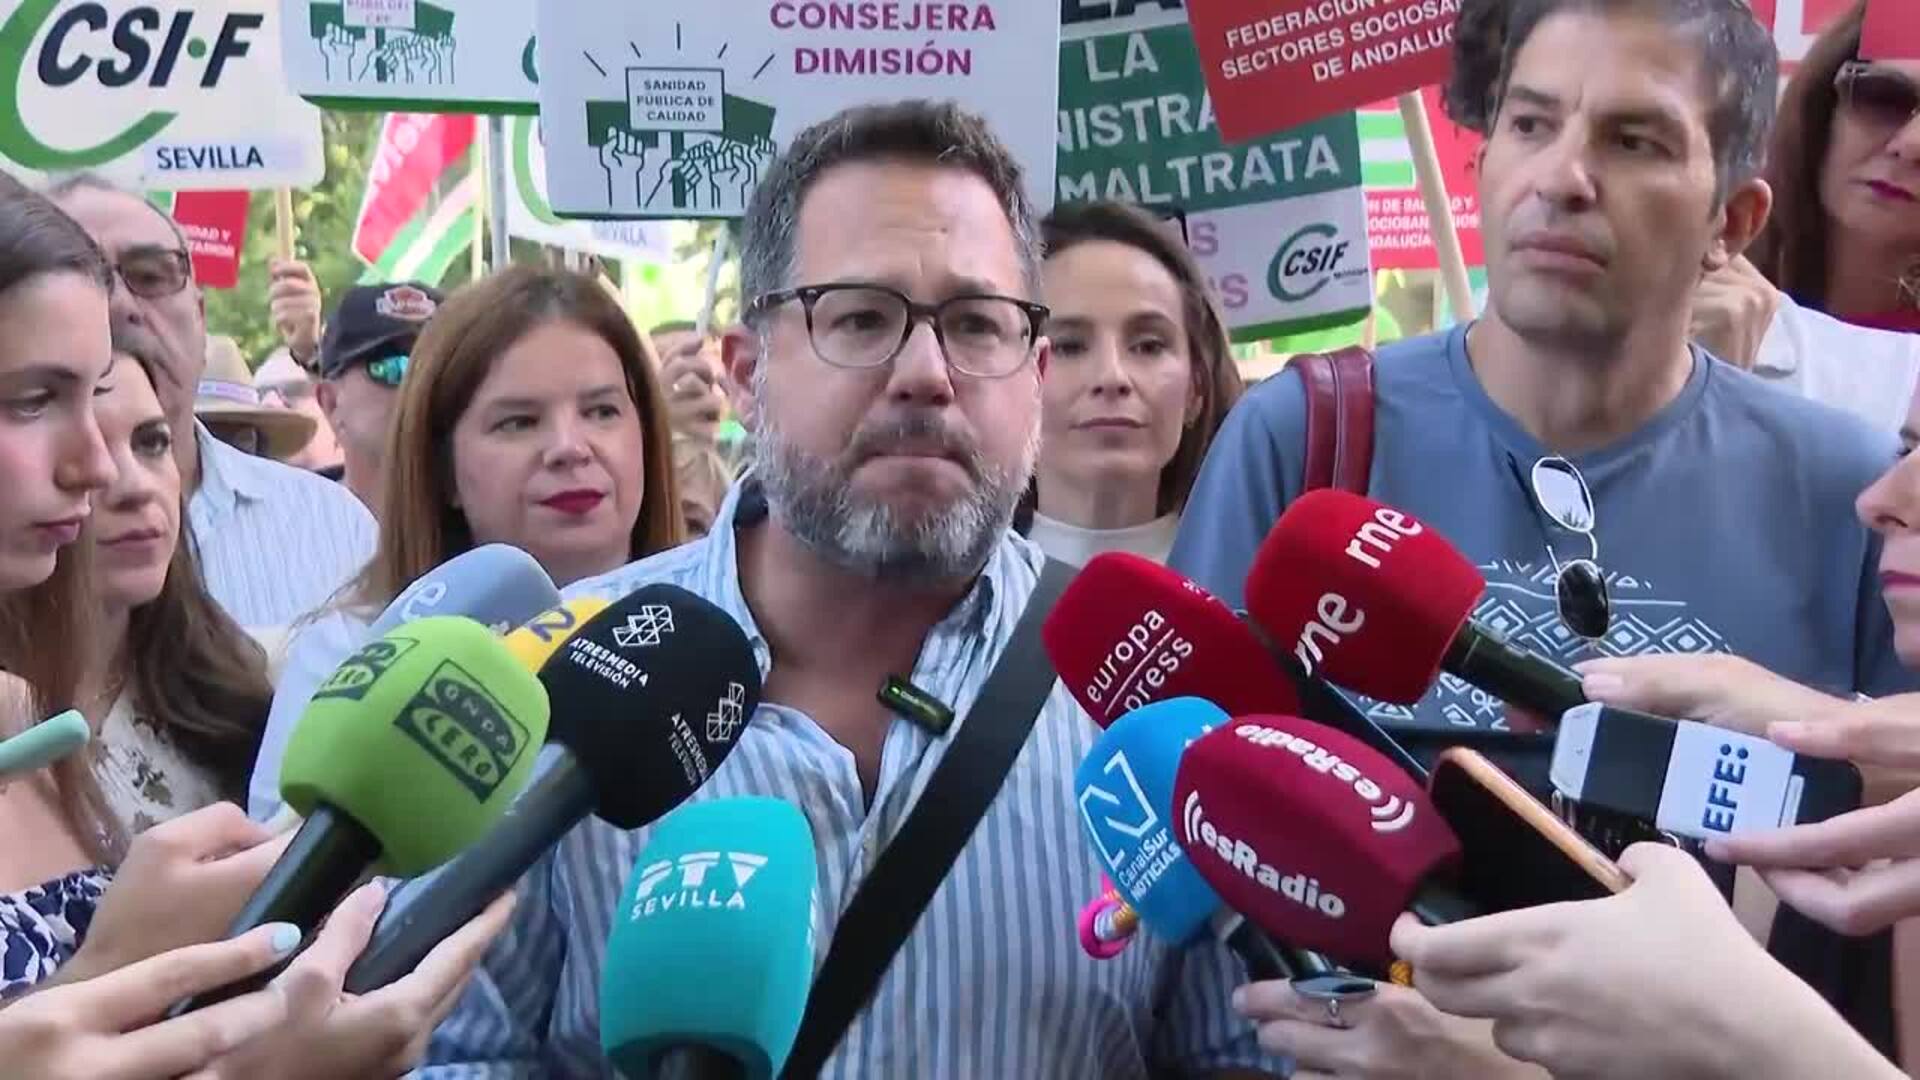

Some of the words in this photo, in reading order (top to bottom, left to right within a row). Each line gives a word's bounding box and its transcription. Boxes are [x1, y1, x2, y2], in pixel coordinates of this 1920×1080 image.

[770, 2, 996, 31] CONSEJERA
[794, 40, 971, 75] DIMISIÓN
[1084, 32, 1159, 82] LA
[1221, 30, 1345, 79] SECTORES
[1312, 57, 1345, 82] DE
[1350, 24, 1455, 72] ANDALUC
[643, 79, 706, 91] SANIDAD
[697, 96, 714, 107] DE
[647, 111, 706, 121] CALIDAD
[156, 146, 264, 169] SEVILLA
[1058, 135, 1341, 204] MALTRATA
[1284, 240, 1350, 276] CSIF
[1345, 508, 1423, 568] rne
[569, 637, 648, 687] ATRESMEDIA
[1086, 610, 1165, 702] europa
[1294, 592, 1365, 677] rne
[1124, 637, 1193, 712] press
[425, 713, 492, 777] CERO
[444, 683, 509, 749] ONDA
[1235, 724, 1382, 800] esRadio
[1118, 827, 1169, 889] CanalSur
[1130, 841, 1182, 903] NOTICIAS
[1200, 821, 1345, 918] esRadio
[630, 889, 745, 922] SEVILLA
